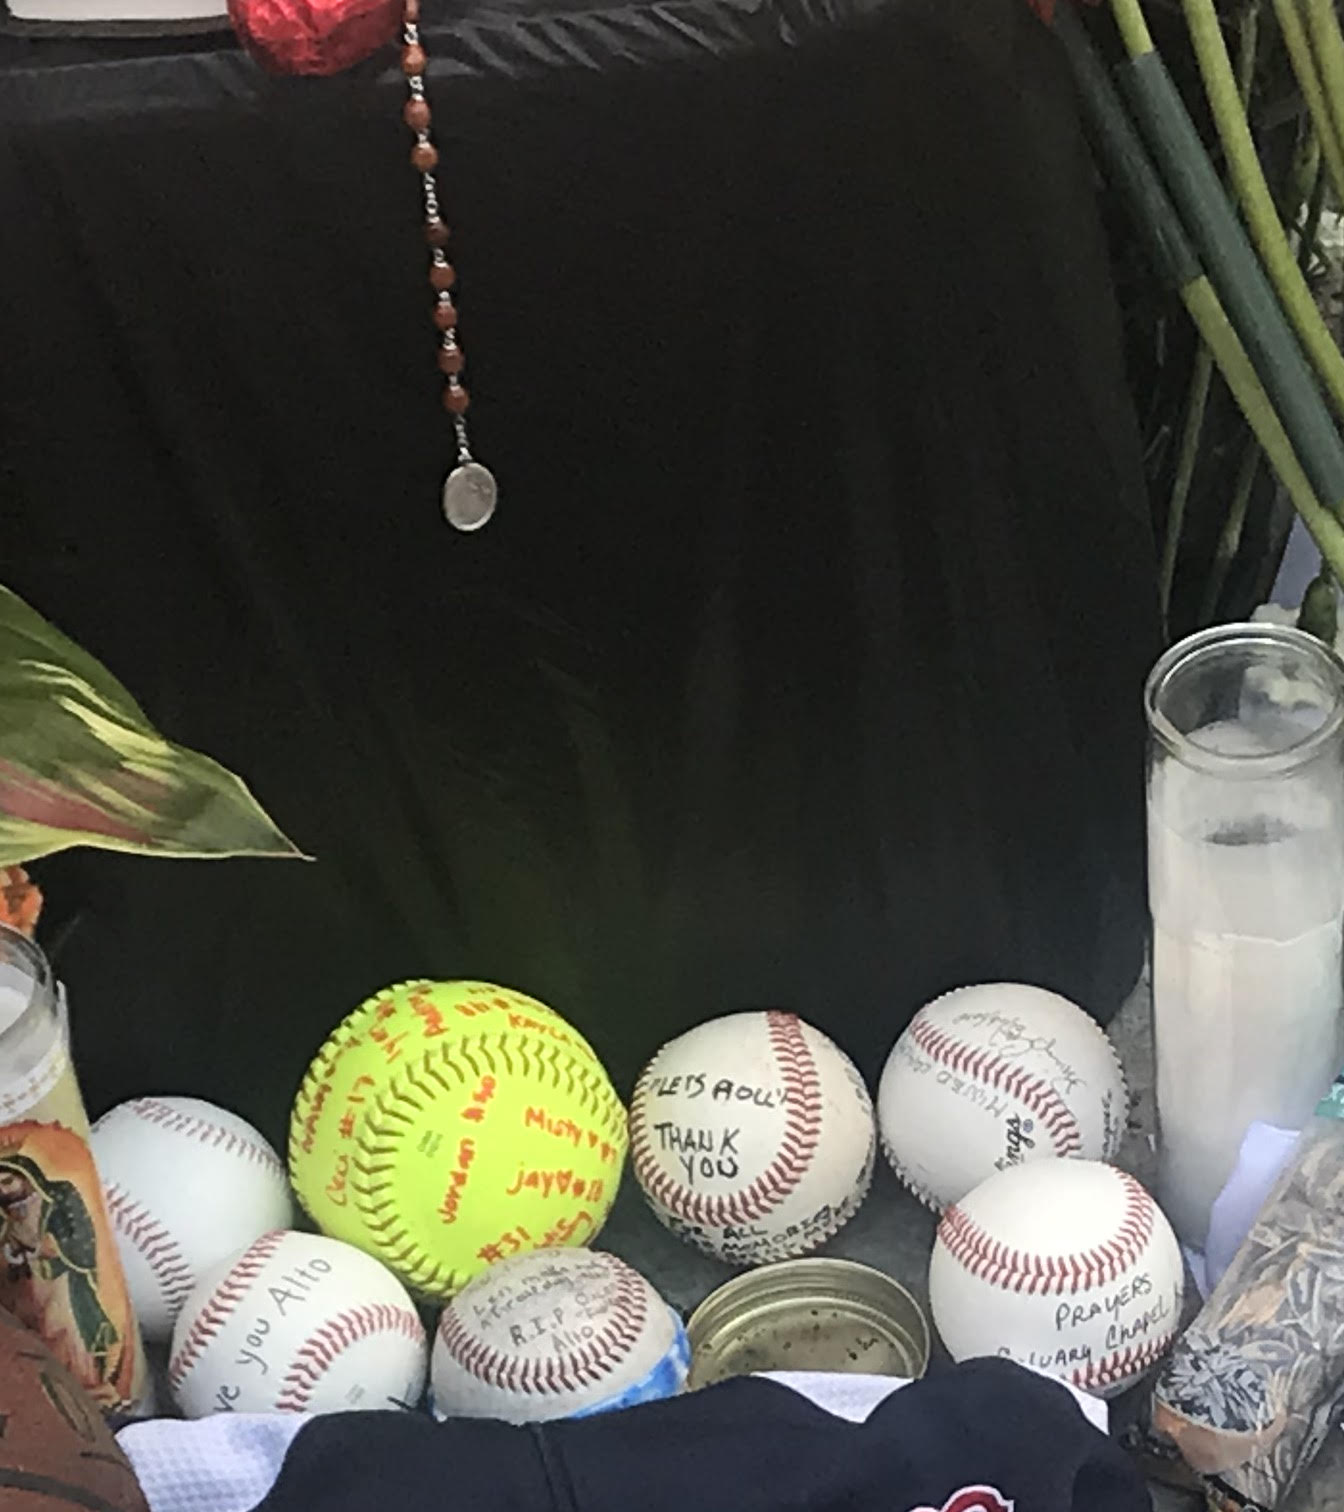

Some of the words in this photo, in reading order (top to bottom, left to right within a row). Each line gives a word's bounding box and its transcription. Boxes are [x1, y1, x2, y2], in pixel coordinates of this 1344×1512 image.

[654, 1122, 740, 1154] THANK
[680, 1155, 739, 1185] YOU
[236, 1318, 271, 1376] you
[267, 1257, 333, 1317] Alto
[1056, 1273, 1154, 1331] PRAYERS
